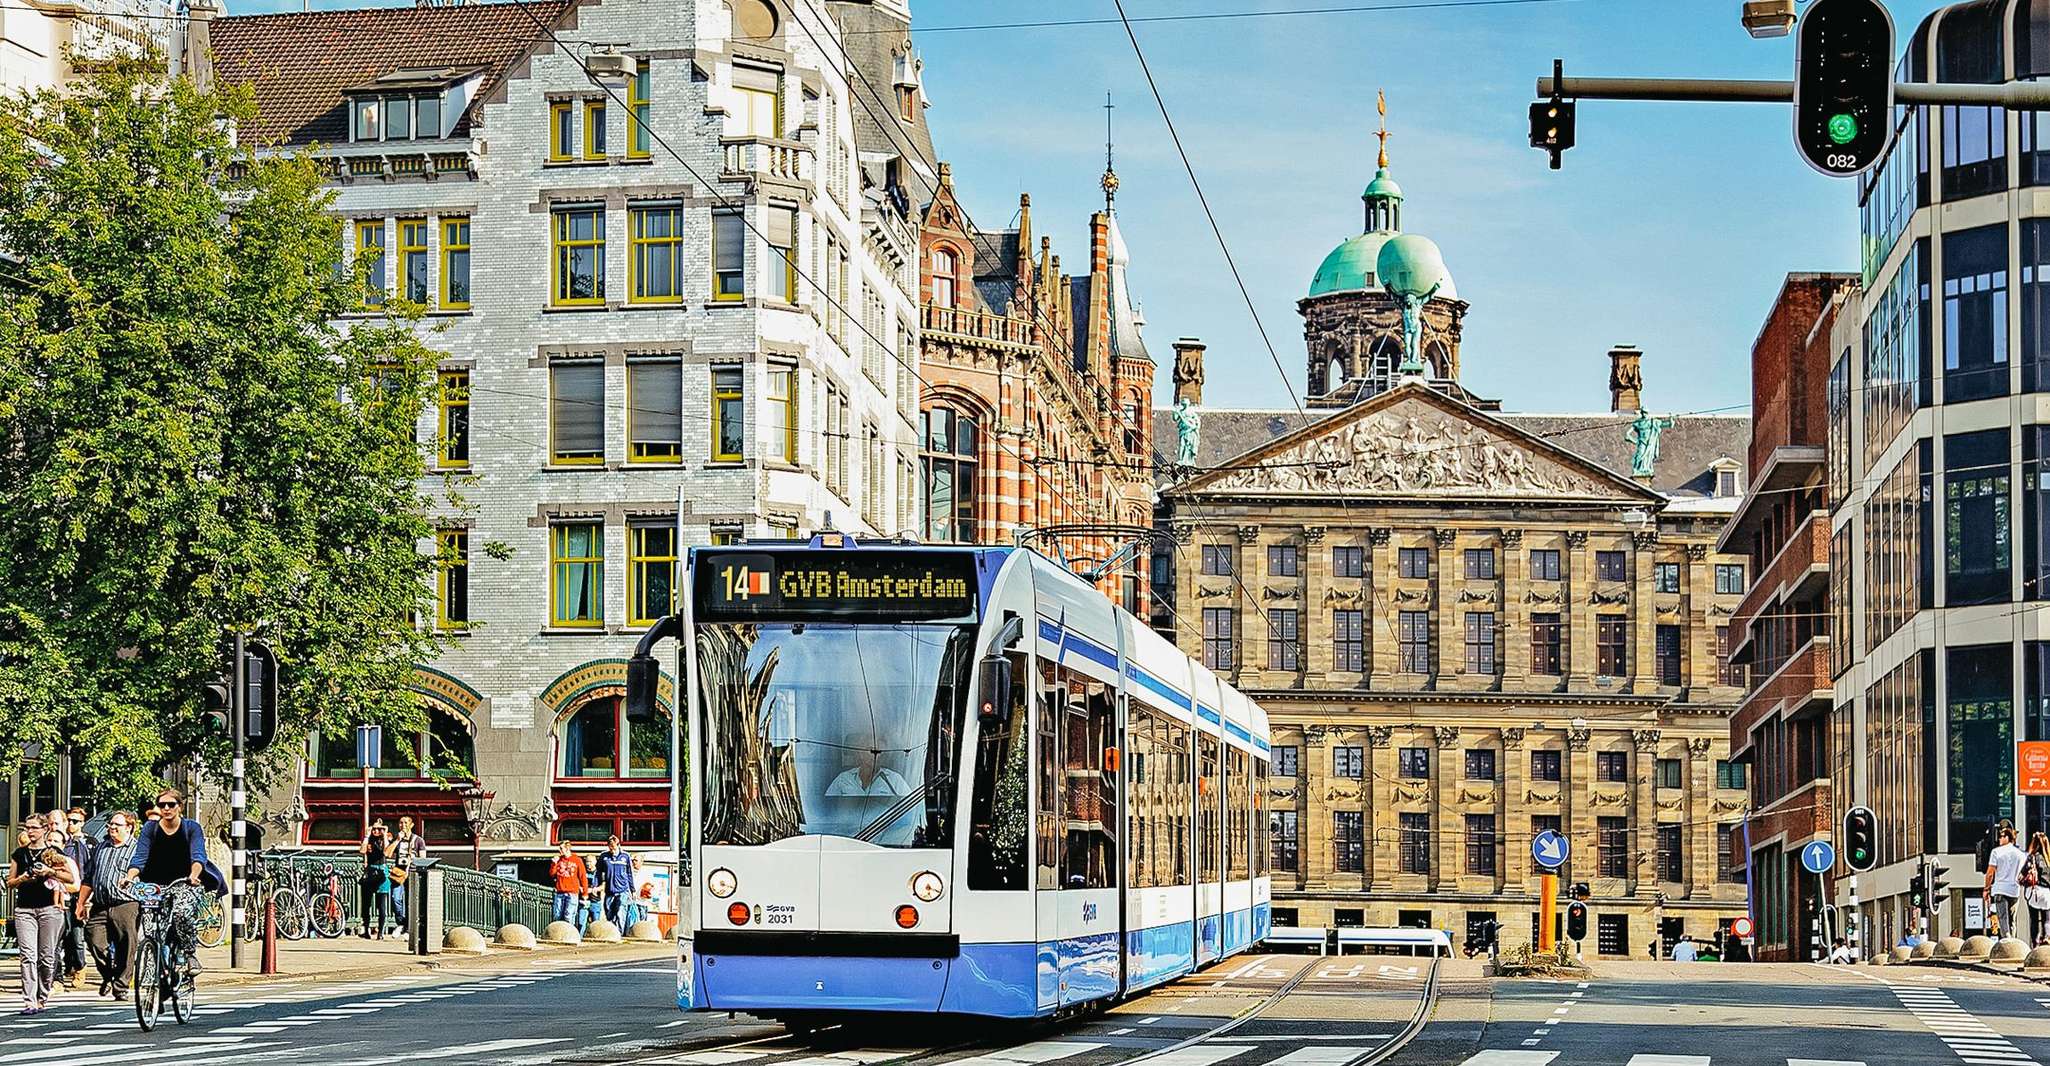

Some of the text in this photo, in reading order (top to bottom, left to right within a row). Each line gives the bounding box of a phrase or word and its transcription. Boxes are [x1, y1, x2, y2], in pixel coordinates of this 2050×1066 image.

[1827, 154, 1857, 168] 082
[721, 566, 967, 600] 14 GVB Amsterdam
[768, 914, 793, 924] 2031
